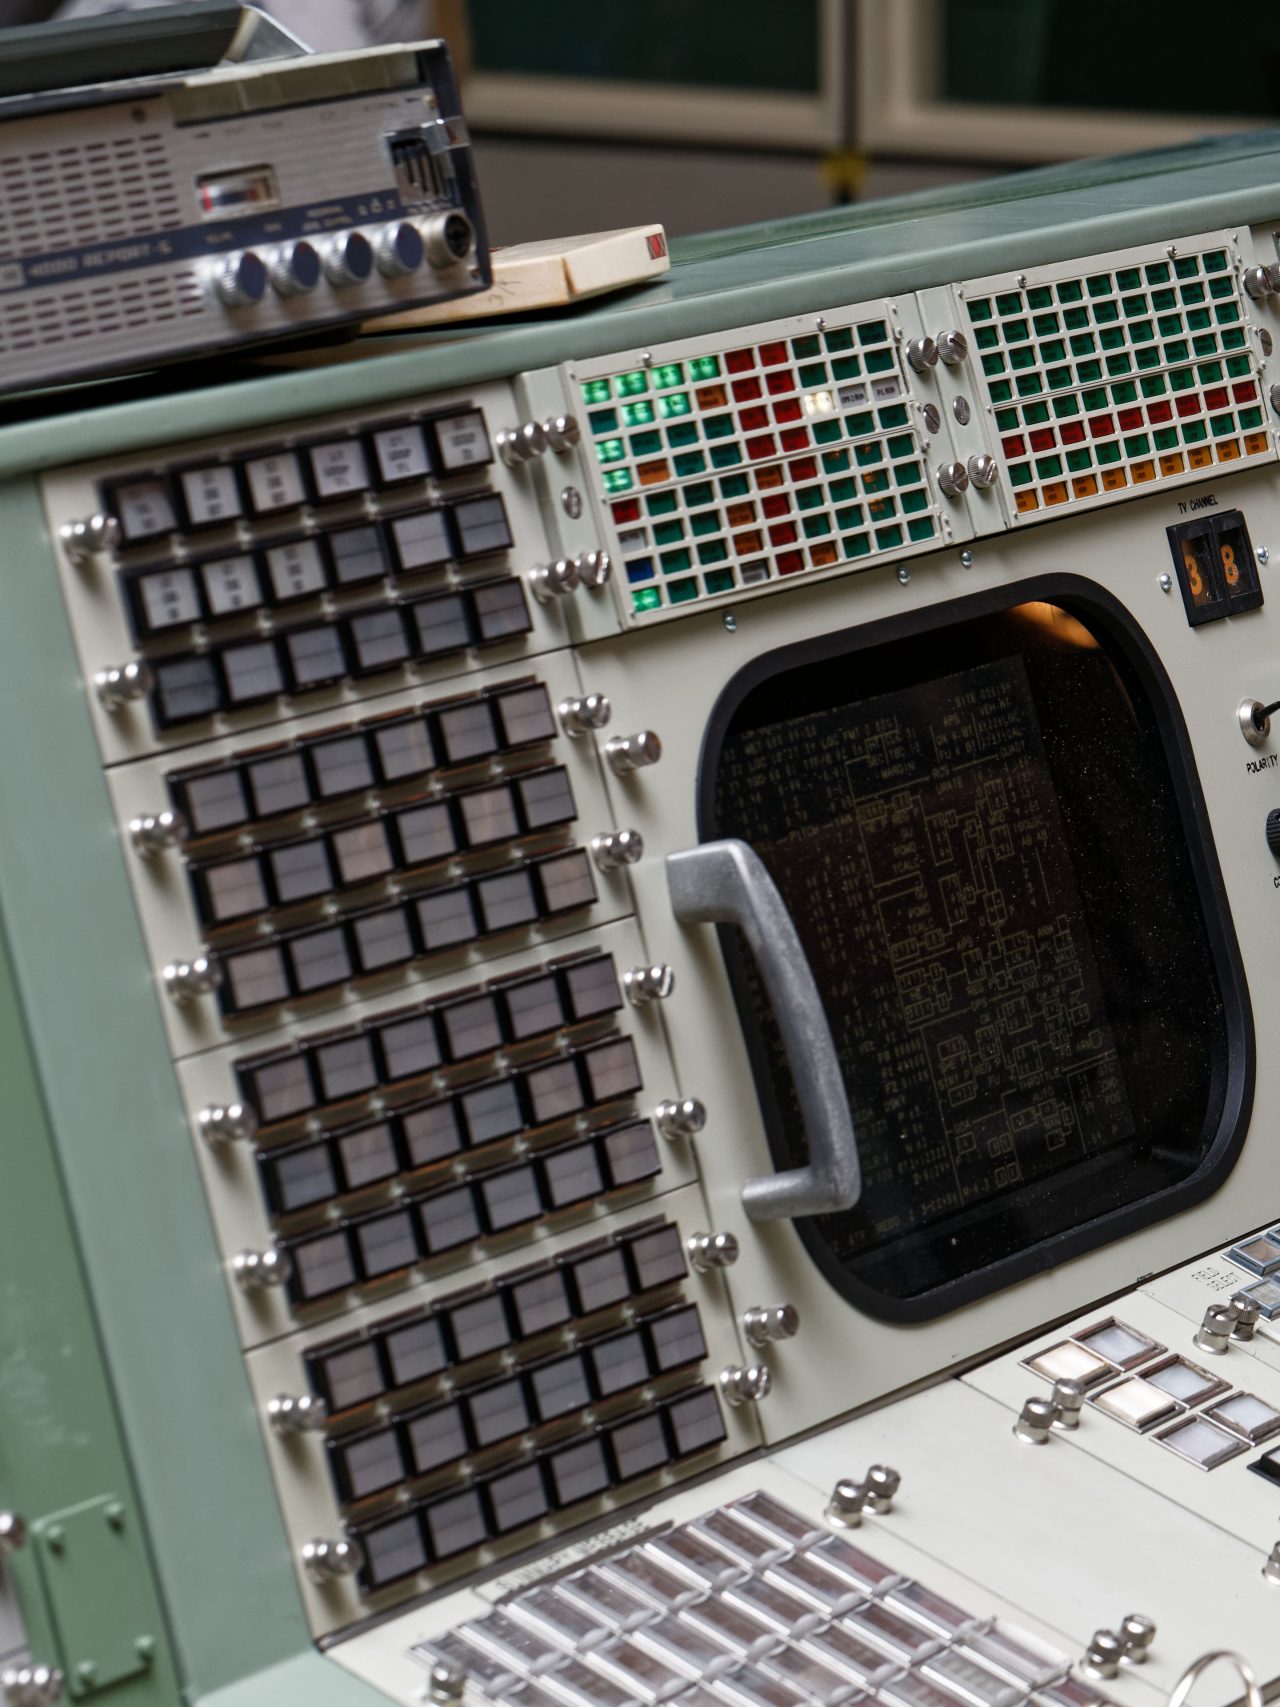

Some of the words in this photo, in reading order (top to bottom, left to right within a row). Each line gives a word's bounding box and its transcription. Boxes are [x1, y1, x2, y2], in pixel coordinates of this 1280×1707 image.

[1177, 501, 1188, 515] TV
[1190, 494, 1219, 512] CHANNEL
[1246, 753, 1279, 775] POLARITY
